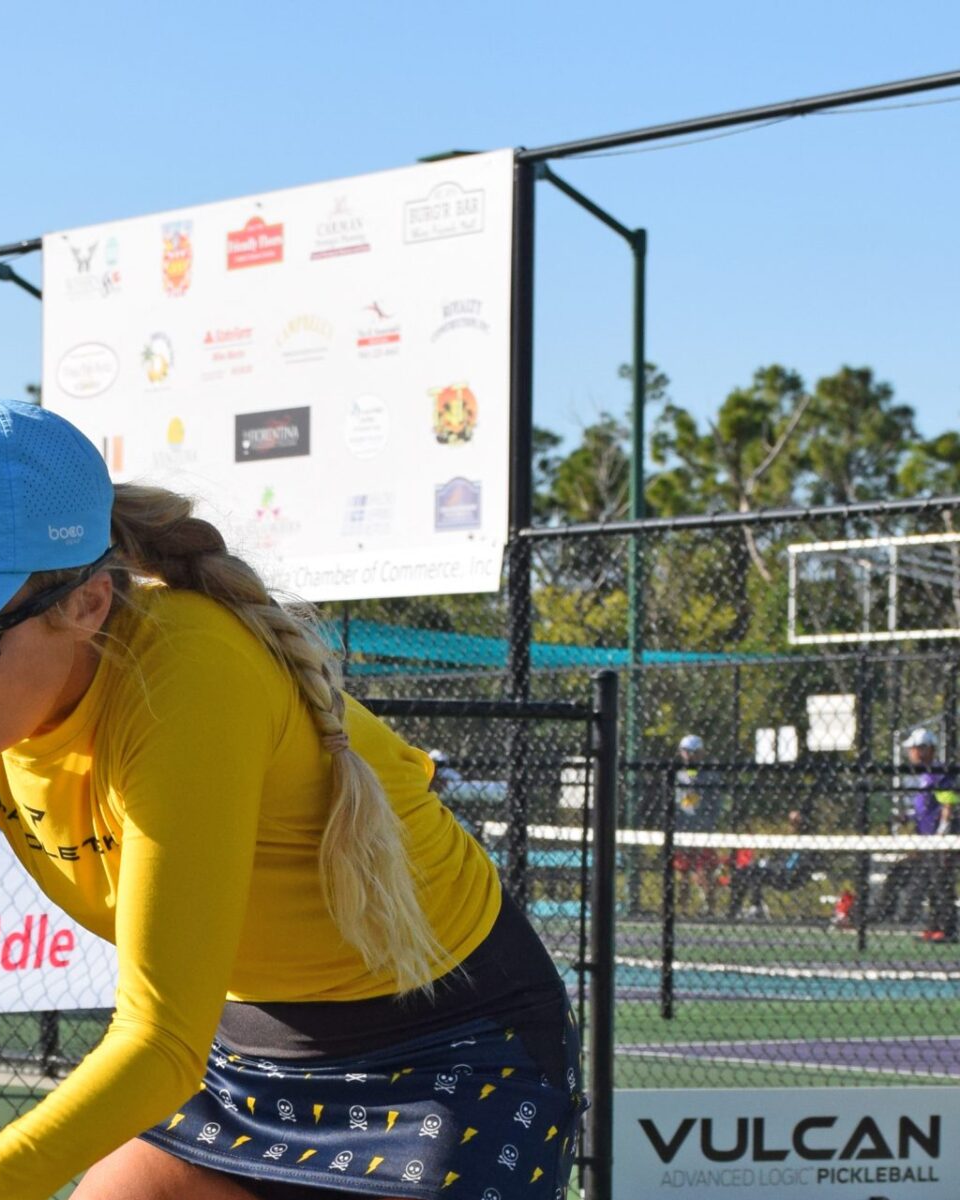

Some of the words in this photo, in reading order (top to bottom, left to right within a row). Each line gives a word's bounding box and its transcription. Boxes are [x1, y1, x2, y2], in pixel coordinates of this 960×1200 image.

[294, 563, 356, 588] Chamber
[362, 562, 378, 584] of
[637, 1114, 942, 1165] VULCAN
[660, 1168, 755, 1189] ADVANCED
[816, 1165, 940, 1186] PICKLEBALL
